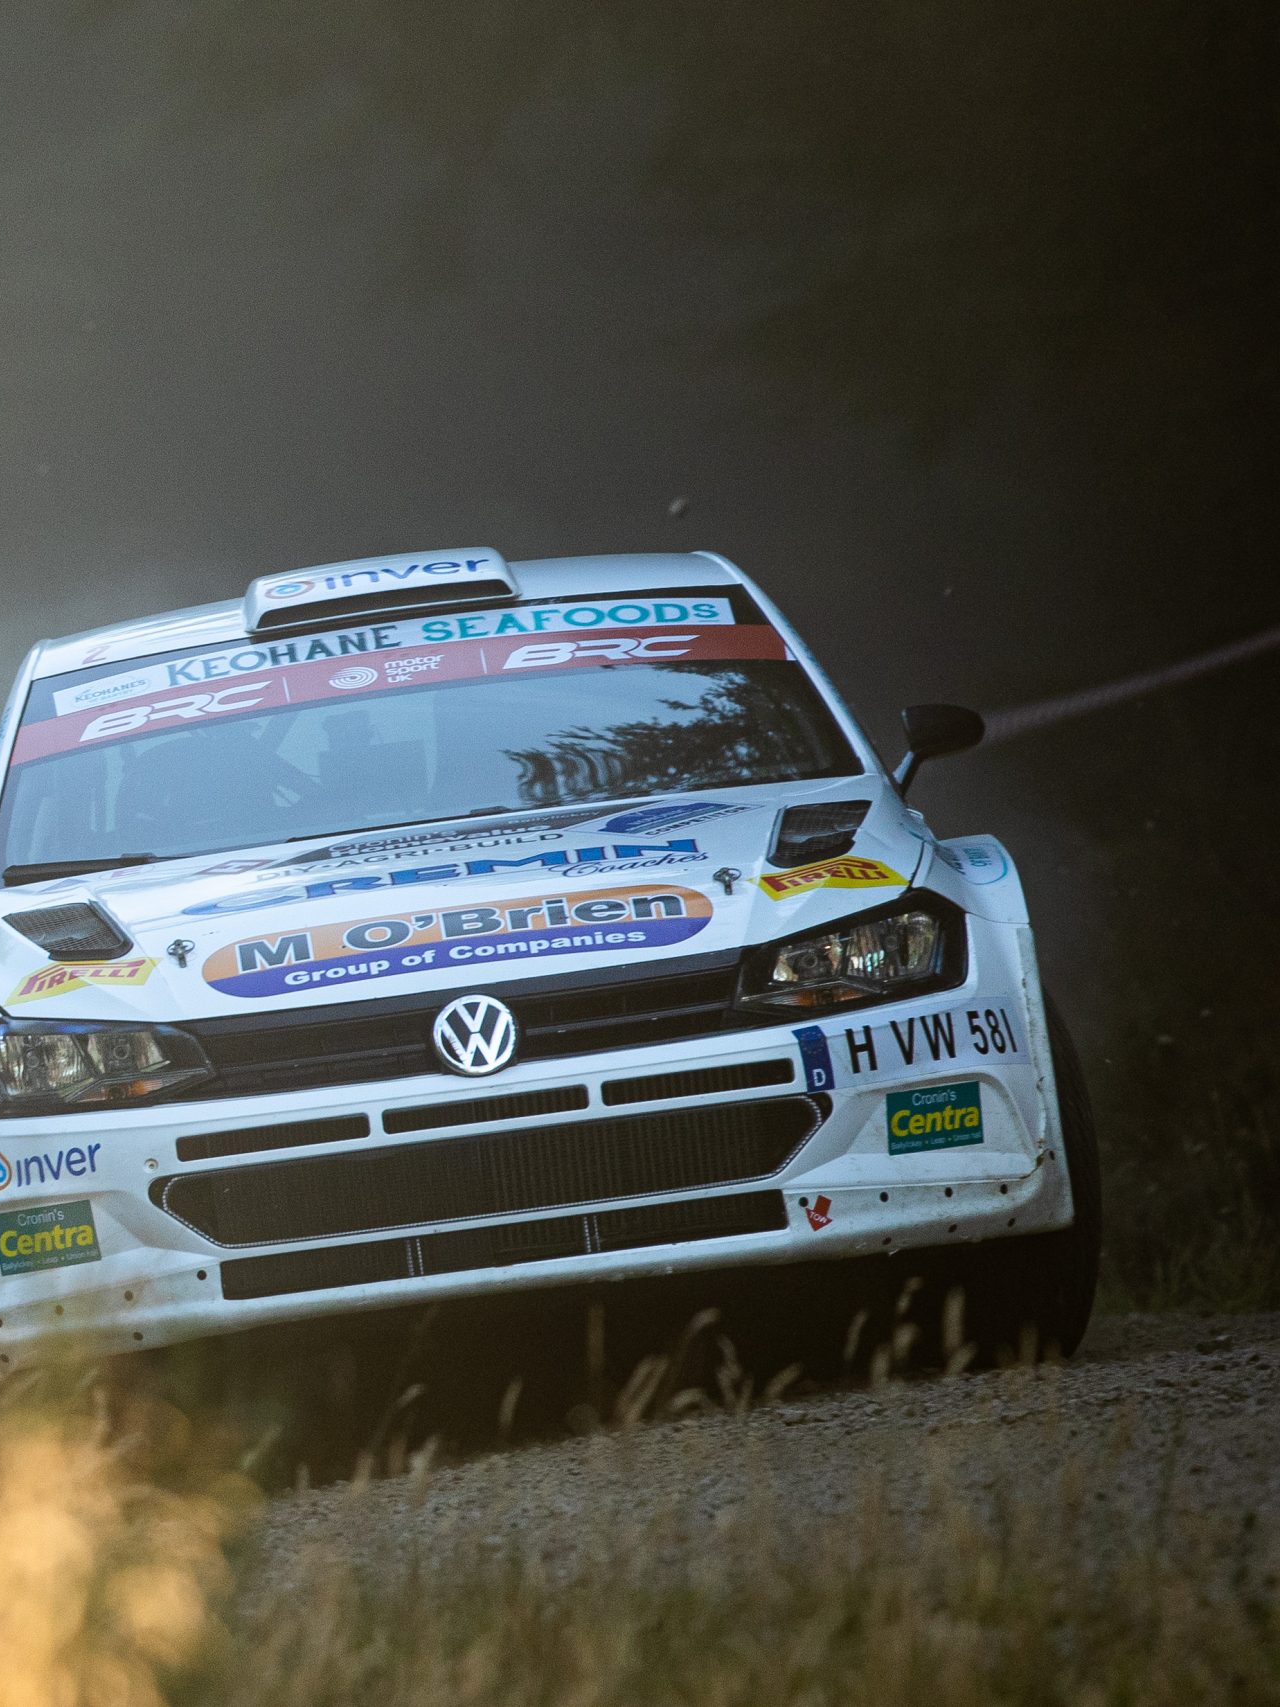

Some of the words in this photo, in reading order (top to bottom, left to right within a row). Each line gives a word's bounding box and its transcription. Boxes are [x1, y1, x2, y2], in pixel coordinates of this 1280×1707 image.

[325, 557, 490, 590] inver
[167, 625, 402, 687] KEOHANE
[422, 602, 721, 642] SEAFOODS
[503, 634, 702, 670] BRC
[384, 654, 445, 669] motor
[385, 663, 439, 676] sport
[387, 674, 415, 683] UK
[79, 680, 273, 742] BRC
[328, 830, 458, 852] Cronin's
[181, 839, 699, 915] CREMIN
[548, 850, 710, 877] Coaches
[761, 857, 890, 893] PIRELLI
[236, 932, 314, 975] M
[342, 893, 688, 950] O'Brien
[284, 958, 391, 986] Group
[401, 950, 437, 967] of
[448, 929, 647, 960] Companies
[20, 959, 147, 996] PIRELLI
[845, 1025, 877, 1074] H
[889, 1012, 956, 1066] VW
[813, 1068, 826, 1087] D
[912, 1089, 958, 1106] Cronin's
[891, 1105, 979, 1137] Centra
[16, 1143, 101, 1187] inver
[17, 1208, 65, 1226] Cronin's
[0, 1224, 94, 1257] Centra
